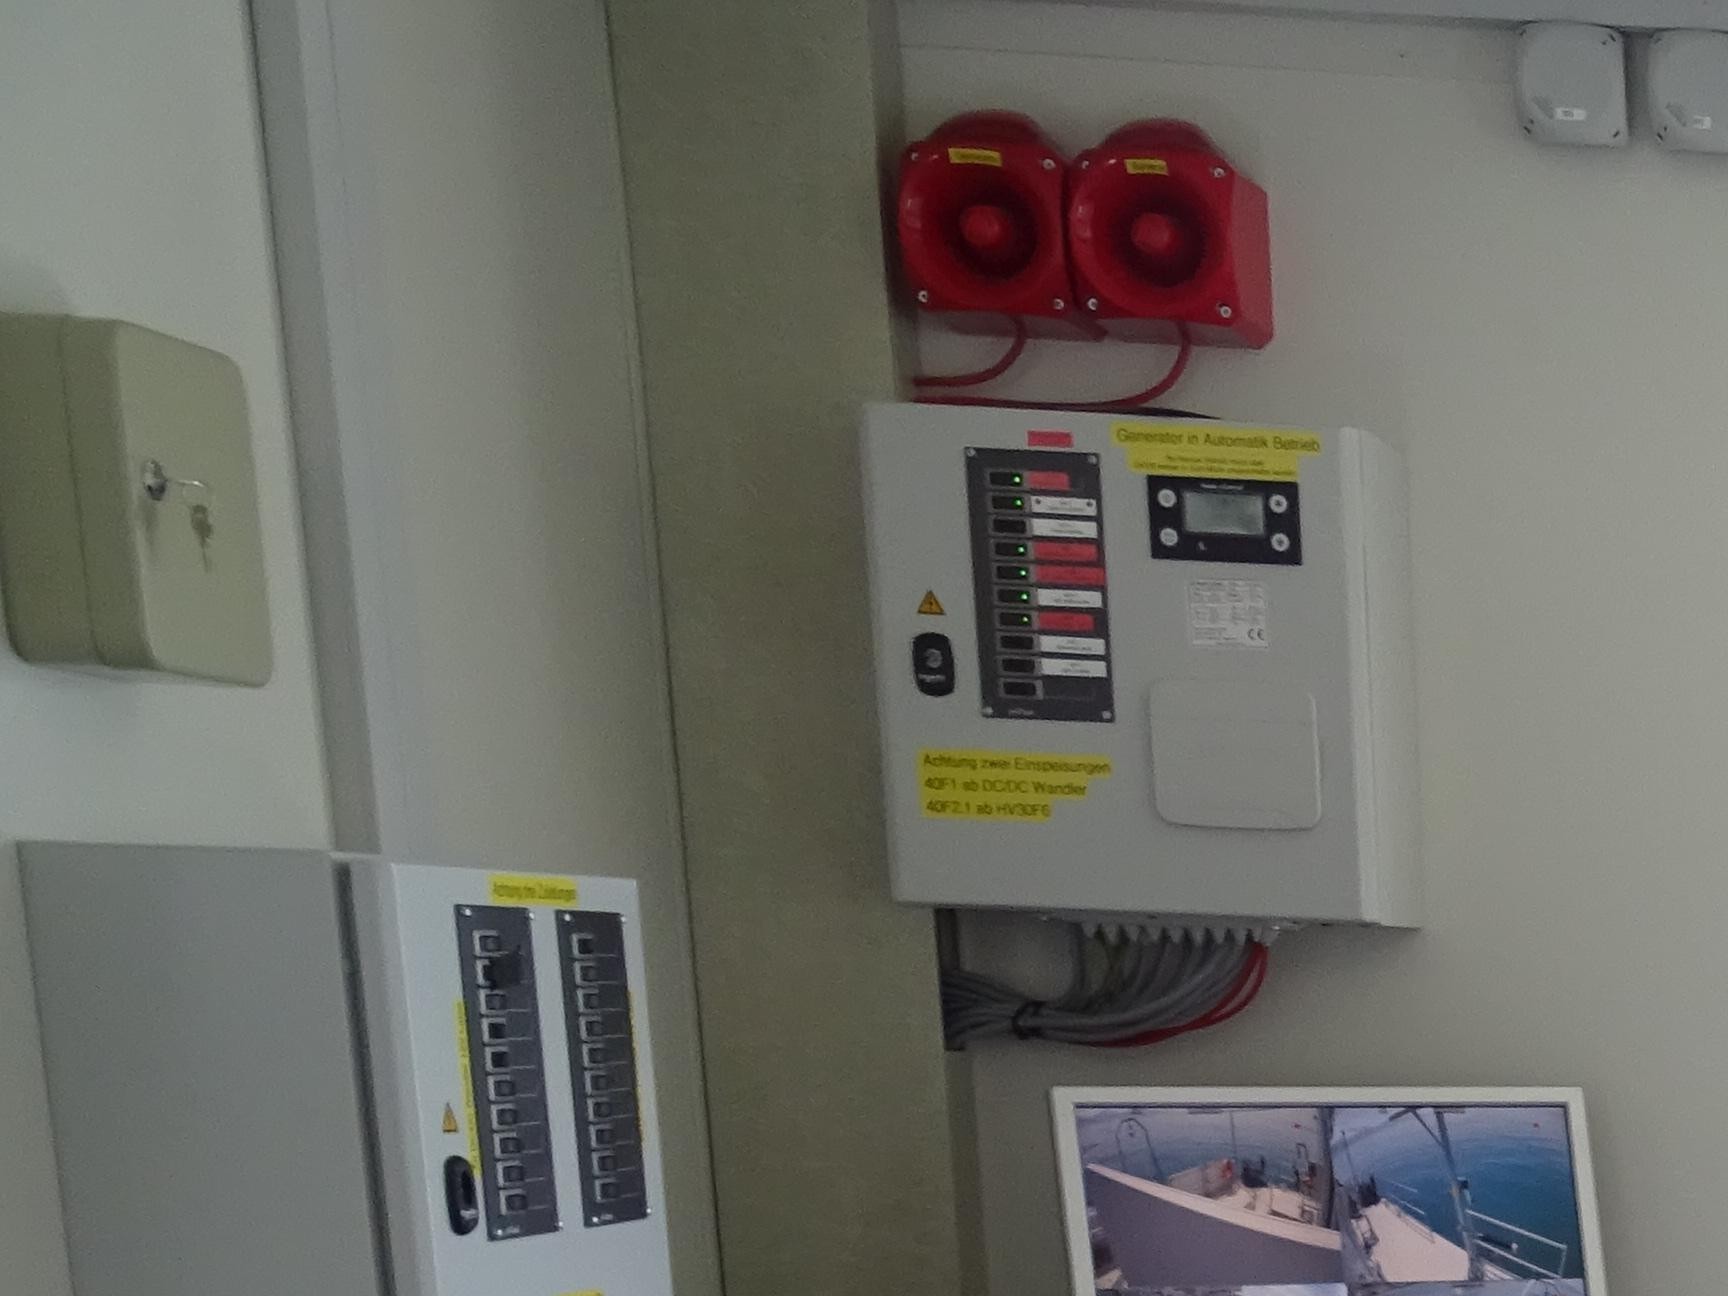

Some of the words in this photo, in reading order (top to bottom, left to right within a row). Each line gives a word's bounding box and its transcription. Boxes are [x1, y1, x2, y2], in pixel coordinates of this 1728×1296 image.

[1116, 428, 1183, 446] Generator
[1187, 431, 1199, 445] in
[1204, 433, 1269, 449] Automatik
[1272, 436, 1321, 452] Betrieb
[923, 754, 978, 771] Achtung
[1014, 757, 1112, 775] Einspeisungen
